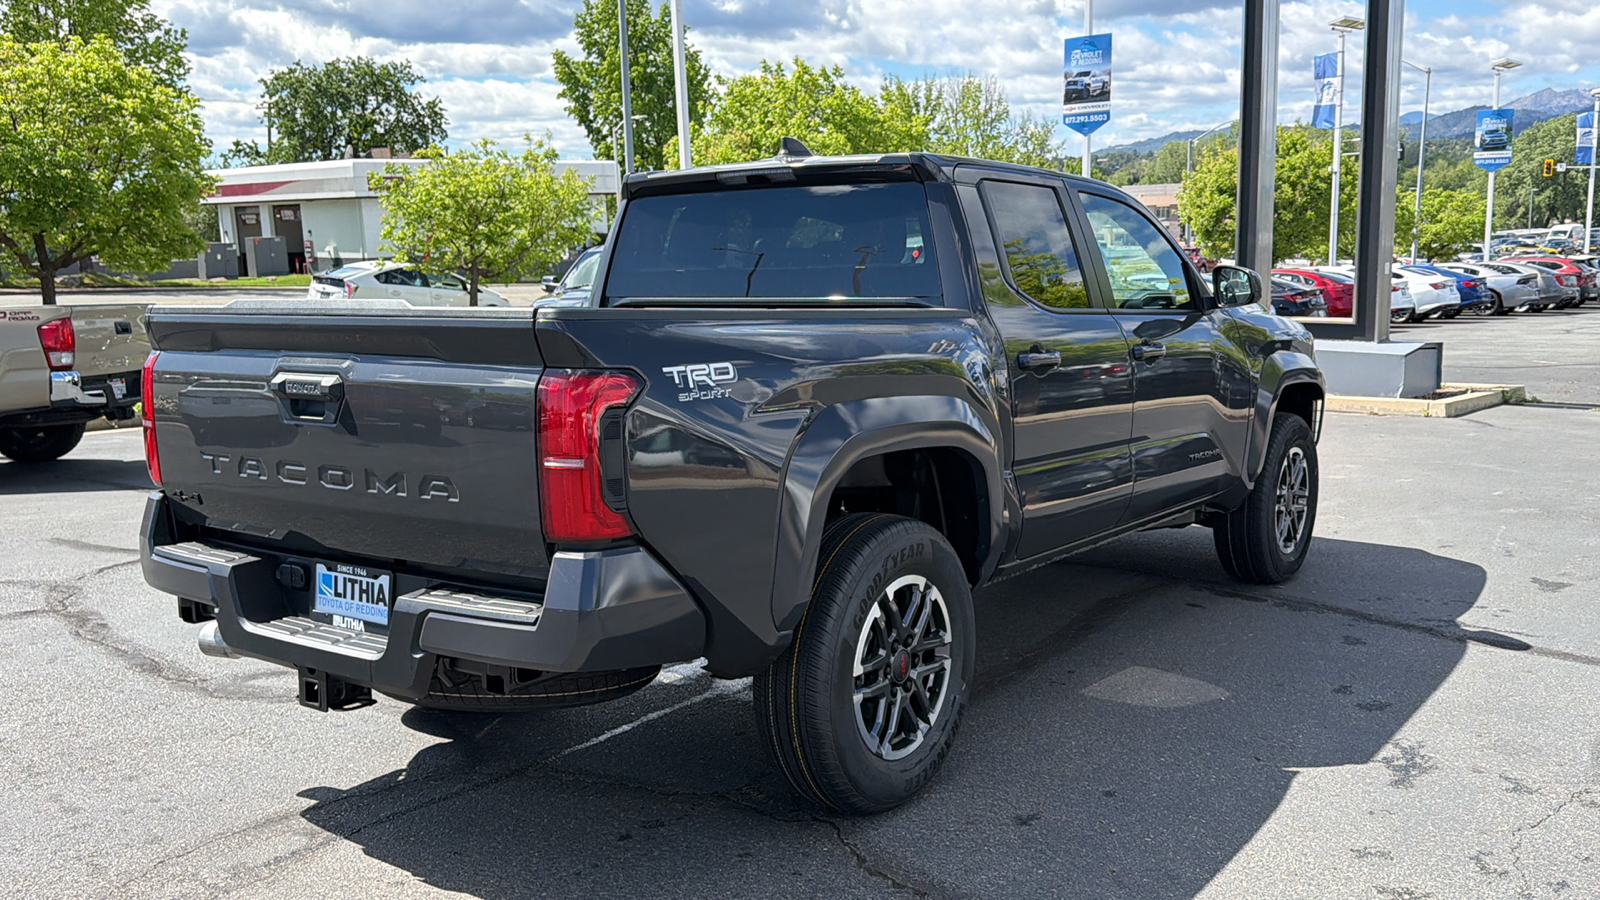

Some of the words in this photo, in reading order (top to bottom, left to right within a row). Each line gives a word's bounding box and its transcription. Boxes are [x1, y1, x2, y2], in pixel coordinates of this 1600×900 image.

[1071, 50, 1102, 60] CHEVROLET
[1065, 114, 1107, 124] 877.293.5503
[662, 362, 735, 389] TRD
[287, 382, 320, 394] TOYOTA
[678, 388, 732, 402] SPORT
[1188, 448, 1221, 461] TACOMA
[200, 450, 460, 503] TACOMA
[337, 564, 353, 574] SINCE
[354, 567, 367, 576] 1946
[333, 575, 388, 607] LITHIA
[318, 596, 344, 610] TOYOTA
[344, 601, 354, 611] OF
[355, 604, 388, 619] REDDING
[341, 615, 365, 632] LITHIA
